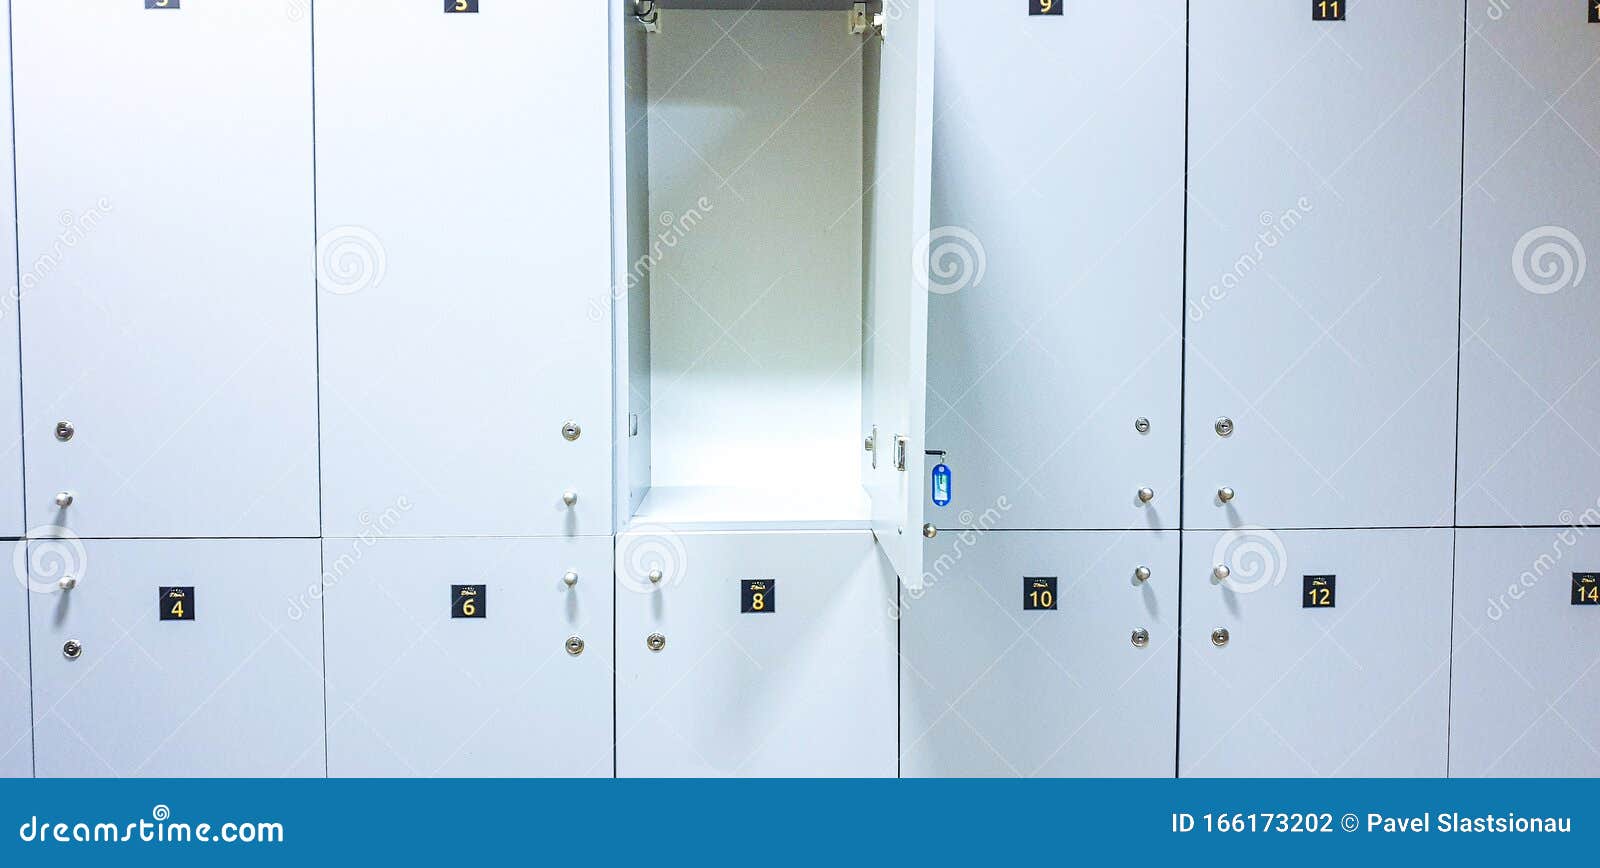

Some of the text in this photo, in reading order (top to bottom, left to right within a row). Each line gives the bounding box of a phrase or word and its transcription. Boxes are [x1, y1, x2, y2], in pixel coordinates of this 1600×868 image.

[1040, 0, 1052, 13] 9
[1318, 1, 1339, 18] 11
[752, 592, 765, 611] 8
[1029, 590, 1052, 608] 10
[1308, 588, 1331, 606] 12
[1577, 586, 1599, 602] 14
[171, 600, 184, 618] 4
[462, 598, 476, 616] 6
